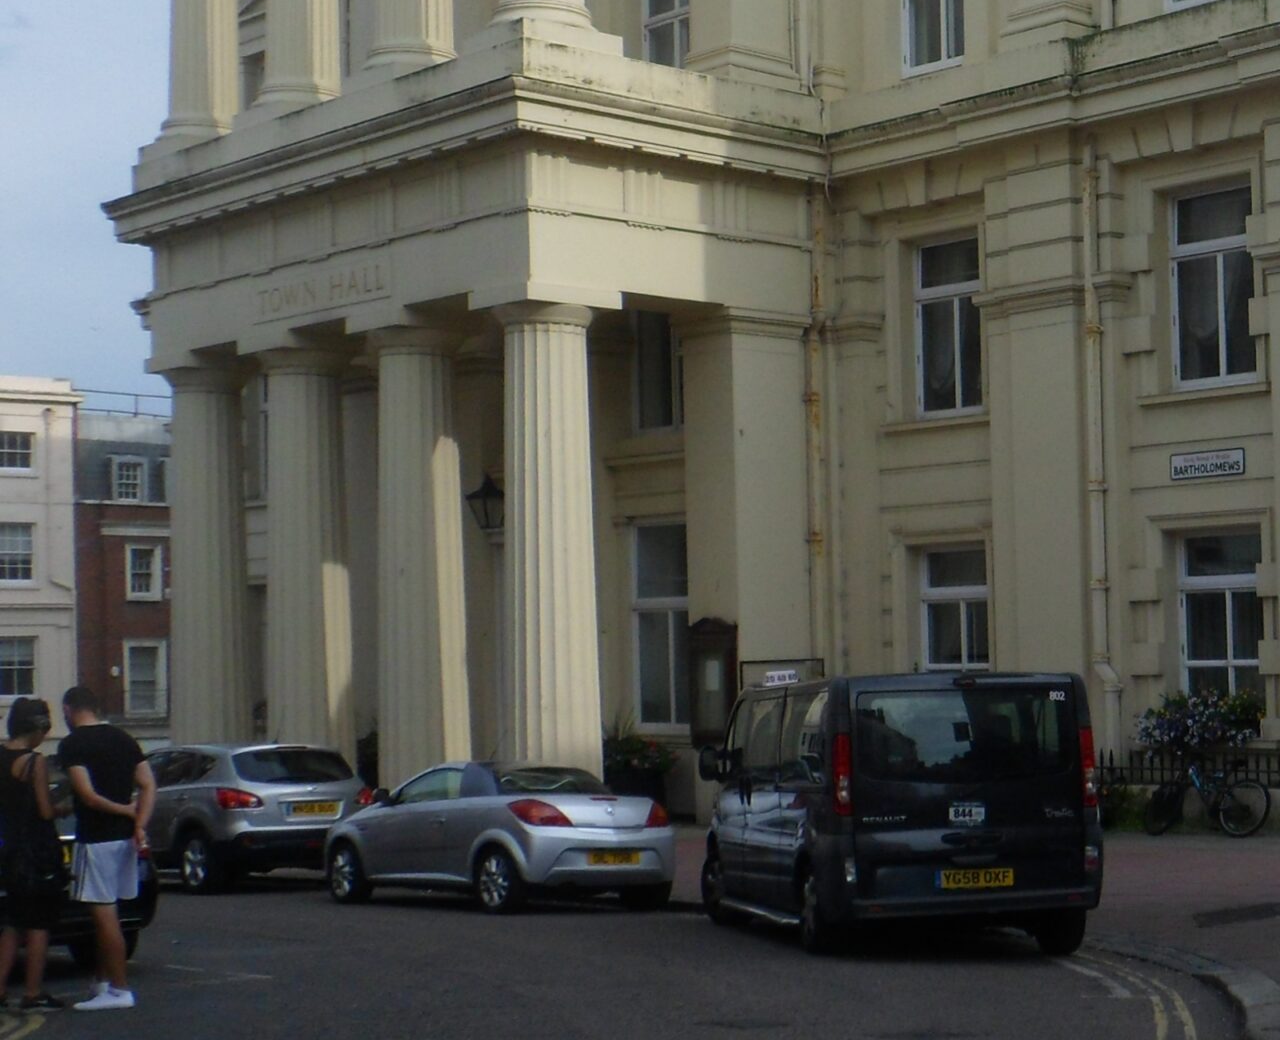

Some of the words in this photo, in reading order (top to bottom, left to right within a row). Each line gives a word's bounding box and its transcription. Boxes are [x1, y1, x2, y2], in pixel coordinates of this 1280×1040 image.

[257, 280, 317, 316] TOWN
[329, 264, 384, 301] HALL
[1173, 460, 1241, 477] BARTHOLOMEWS
[1049, 690, 1065, 701] 802
[862, 815, 907, 823] RENAULT
[953, 808, 973, 819] 844
[943, 871, 981, 885] YG58
[983, 870, 1010, 884] OXF
